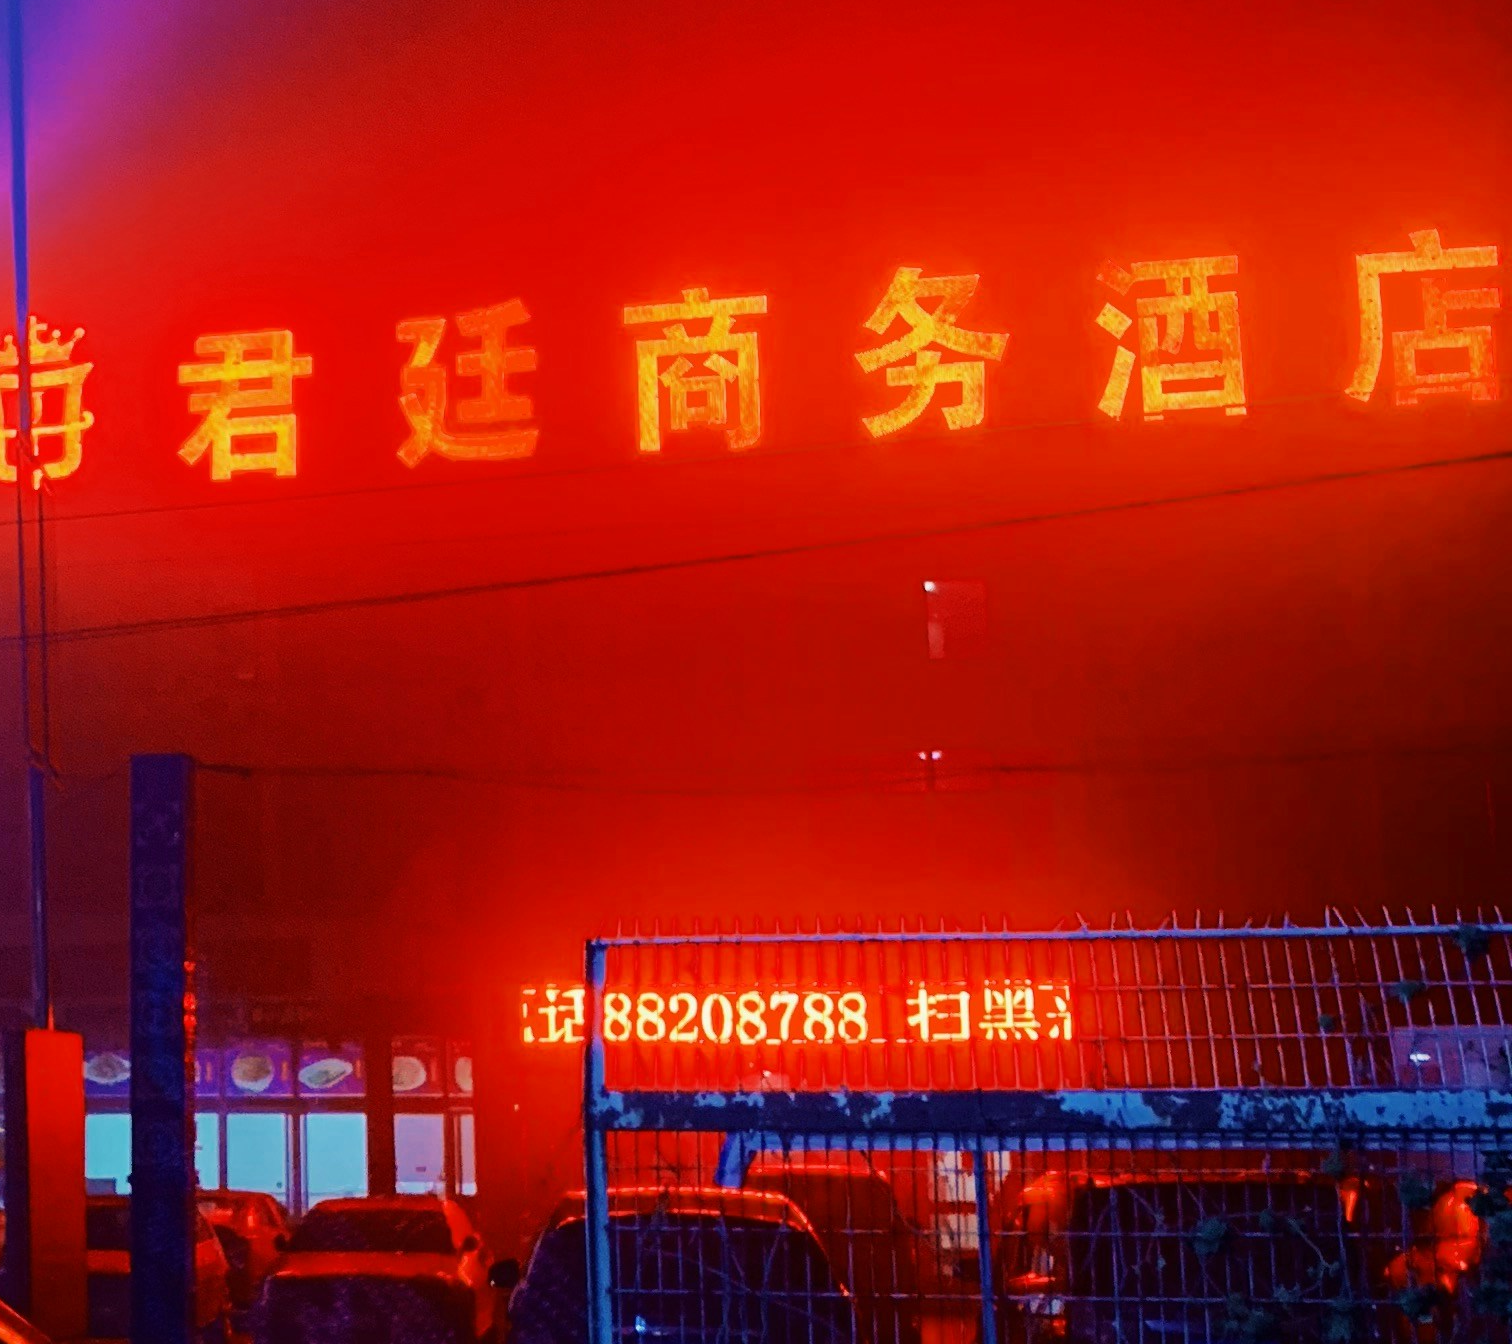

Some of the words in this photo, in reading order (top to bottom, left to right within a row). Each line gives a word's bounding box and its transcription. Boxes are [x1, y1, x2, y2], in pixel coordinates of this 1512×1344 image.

[178, 228, 1500, 481] 君廷商务酒店
